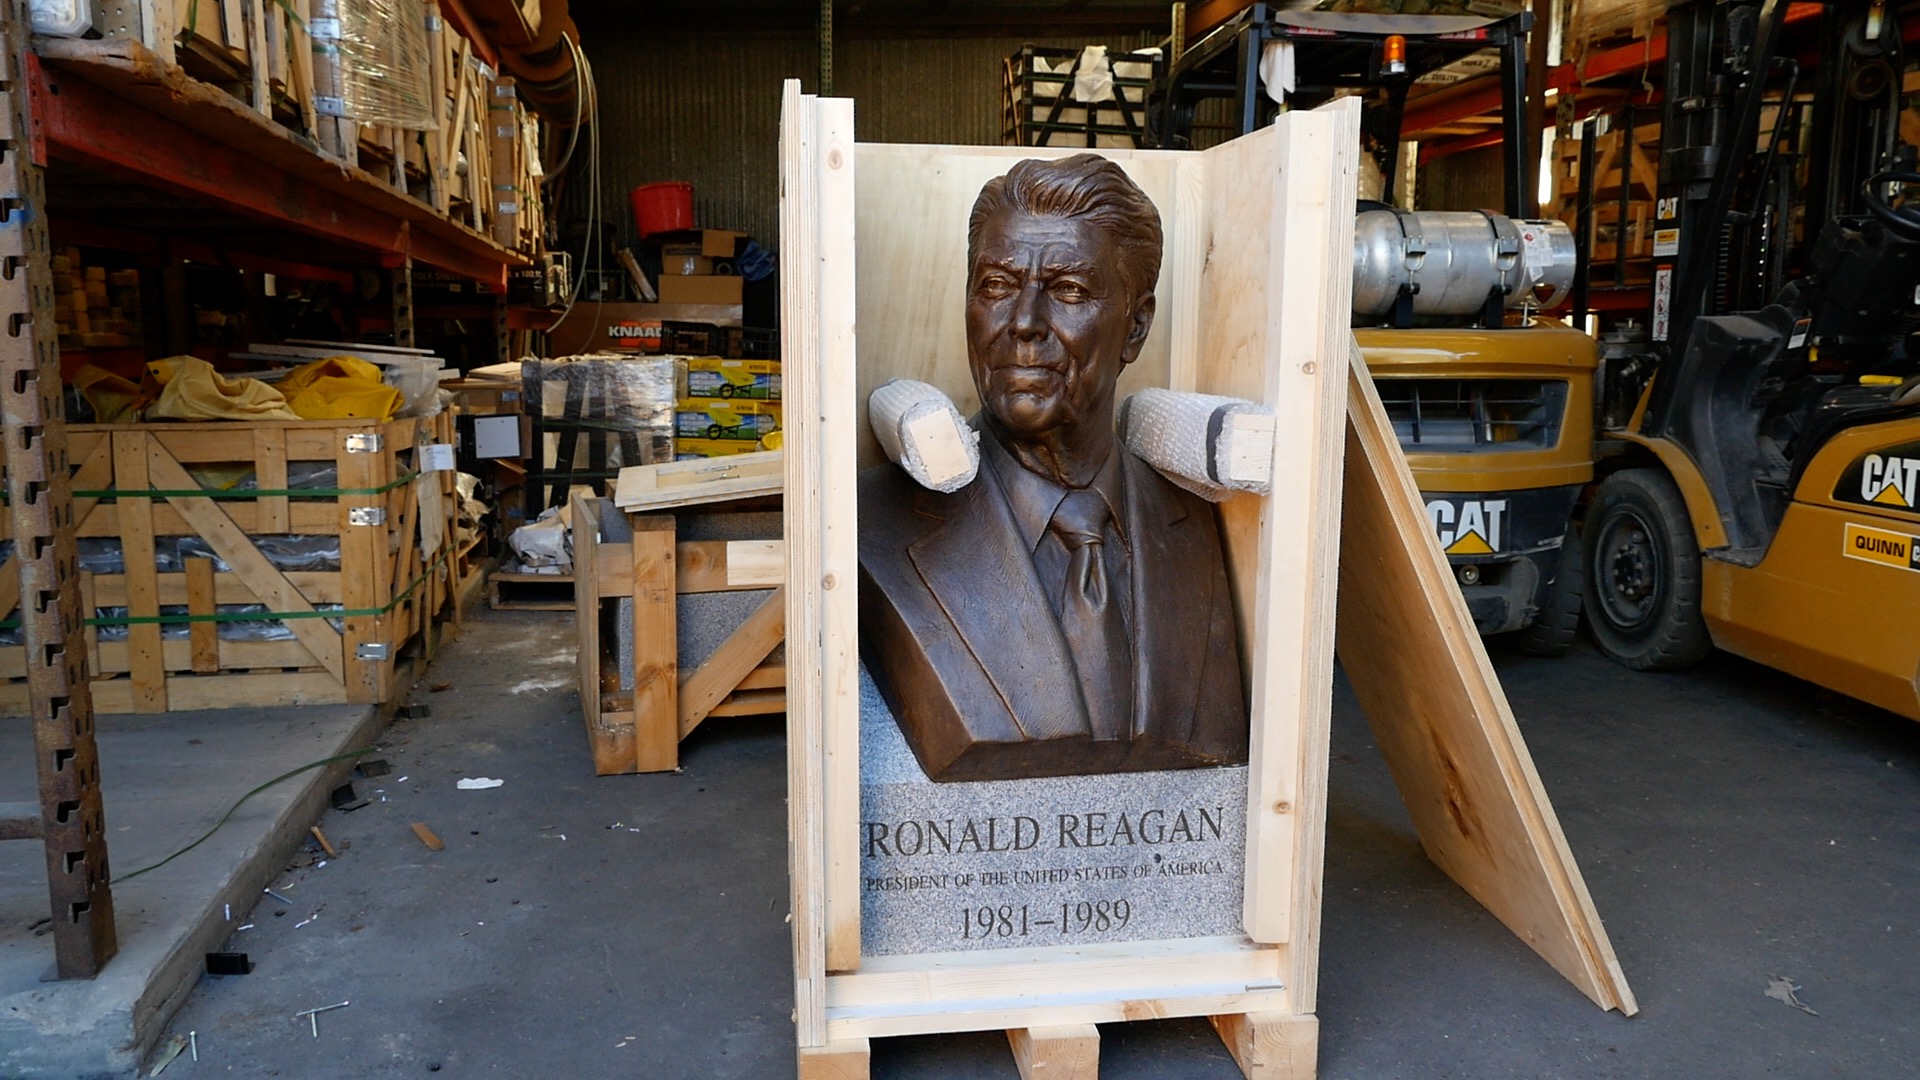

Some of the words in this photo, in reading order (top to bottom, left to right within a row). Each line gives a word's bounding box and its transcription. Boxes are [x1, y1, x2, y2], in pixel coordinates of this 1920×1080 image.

[1657, 197, 1679, 220] CAT
[608, 325, 662, 338] KNAAC
[1861, 453, 1920, 508] CAT
[1426, 500, 1506, 552] CAT
[1855, 535, 1905, 558] QUINN
[866, 815, 1040, 858] RONALD
[1057, 807, 1224, 849] REAGAN
[866, 874, 949, 892] PRESIDENT
[954, 873, 976, 888] OF
[979, 871, 1008, 886] THE
[1014, 868, 1069, 884] UNITED
[1074, 865, 1128, 882] STATES
[1133, 865, 1152, 878] OF
[1158, 861, 1224, 877] AMERICA
